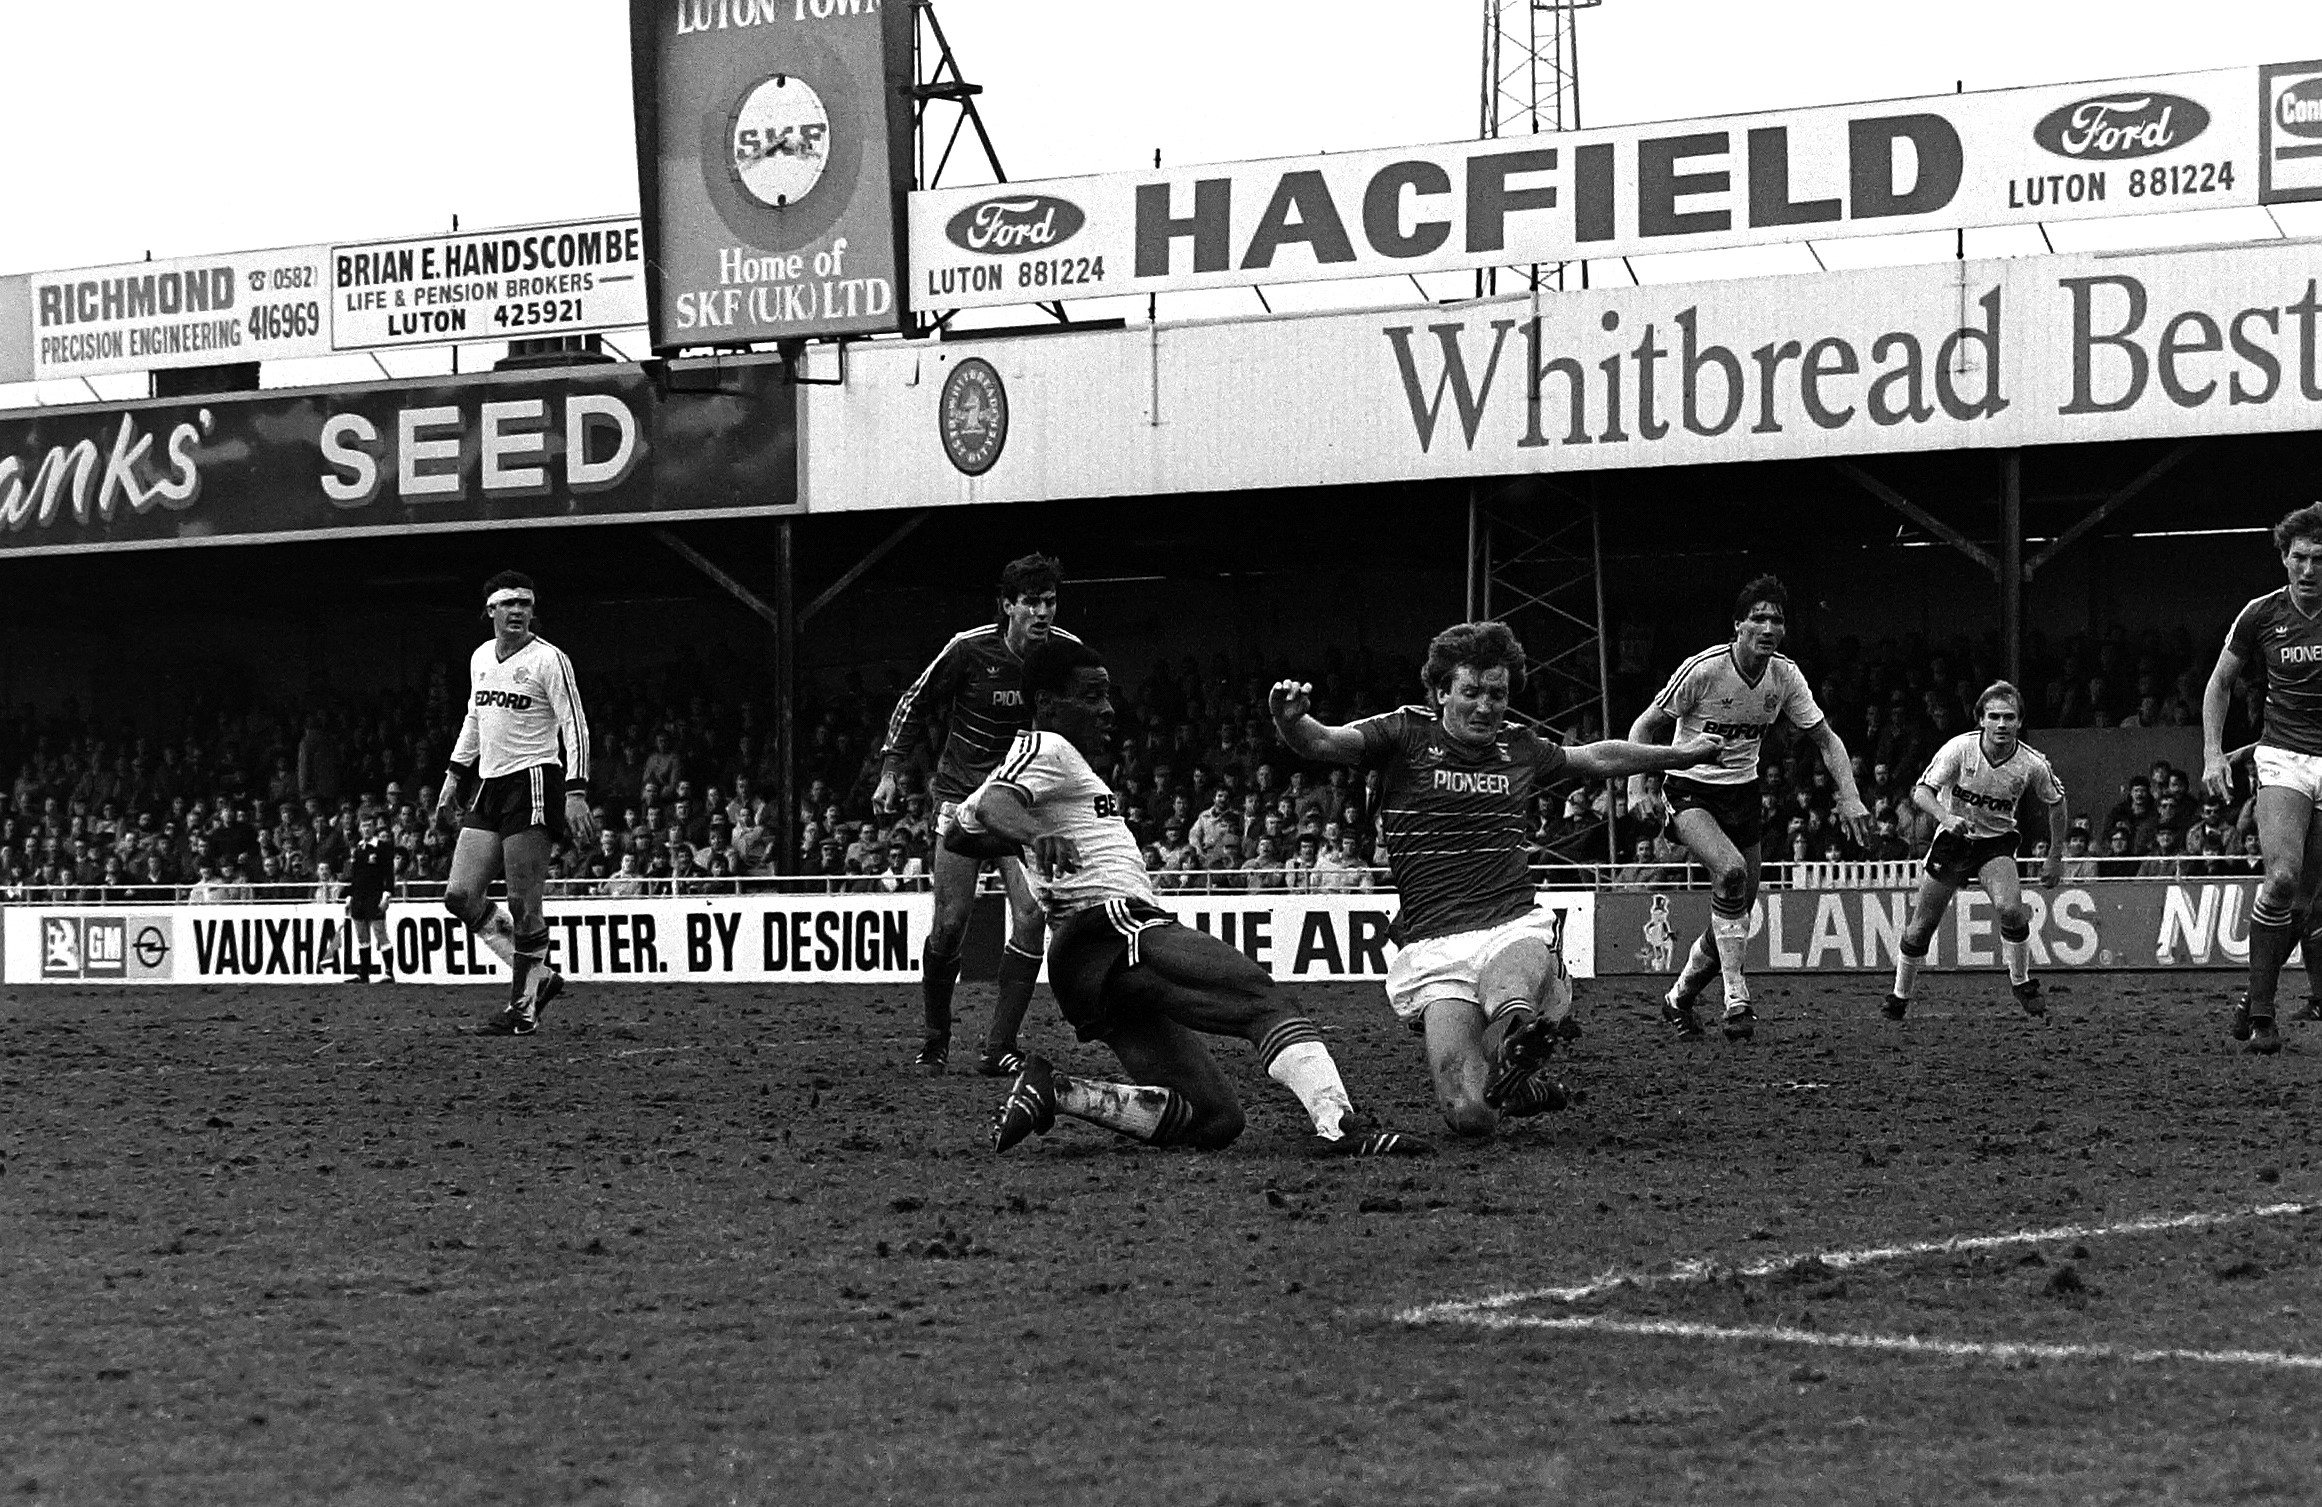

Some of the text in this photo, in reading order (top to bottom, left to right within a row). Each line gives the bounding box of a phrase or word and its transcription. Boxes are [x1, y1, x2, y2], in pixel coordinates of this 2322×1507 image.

[737, 122, 827, 160] SKF
[2061, 97, 2174, 154] Ford
[1134, 112, 1964, 279] HACFIELD
[2008, 160, 2235, 209] LUTON 881224
[966, 199, 1057, 248] Ford
[337, 228, 639, 288] BRIAN E. HANDSCOMBE
[719, 237, 848, 285] Home of
[928, 255, 1105, 296] LUTON 881224
[39, 266, 235, 326] RICHMOND
[348, 273, 594, 312] LIFE & PENSION BROKERS
[675, 278, 892, 329] SKF (UK) LTD
[41, 318, 242, 364] PRECISION ENGINEERING
[248, 301, 319, 340] 416969
[388, 298, 583, 336] LUTON 425921
[1382, 272, 2322, 455] Whitbread Best
[320, 394, 637, 500] SEED
[475, 690, 533, 710] EDFORD
[1433, 769, 1511, 796] PIONEER
[88, 925, 121, 960] GM
[396, 917, 497, 975] OPEL.
[544, 913, 668, 973] ETTER.
[687, 911, 742, 973] BY
[763, 910, 920, 972] DESIGN.
